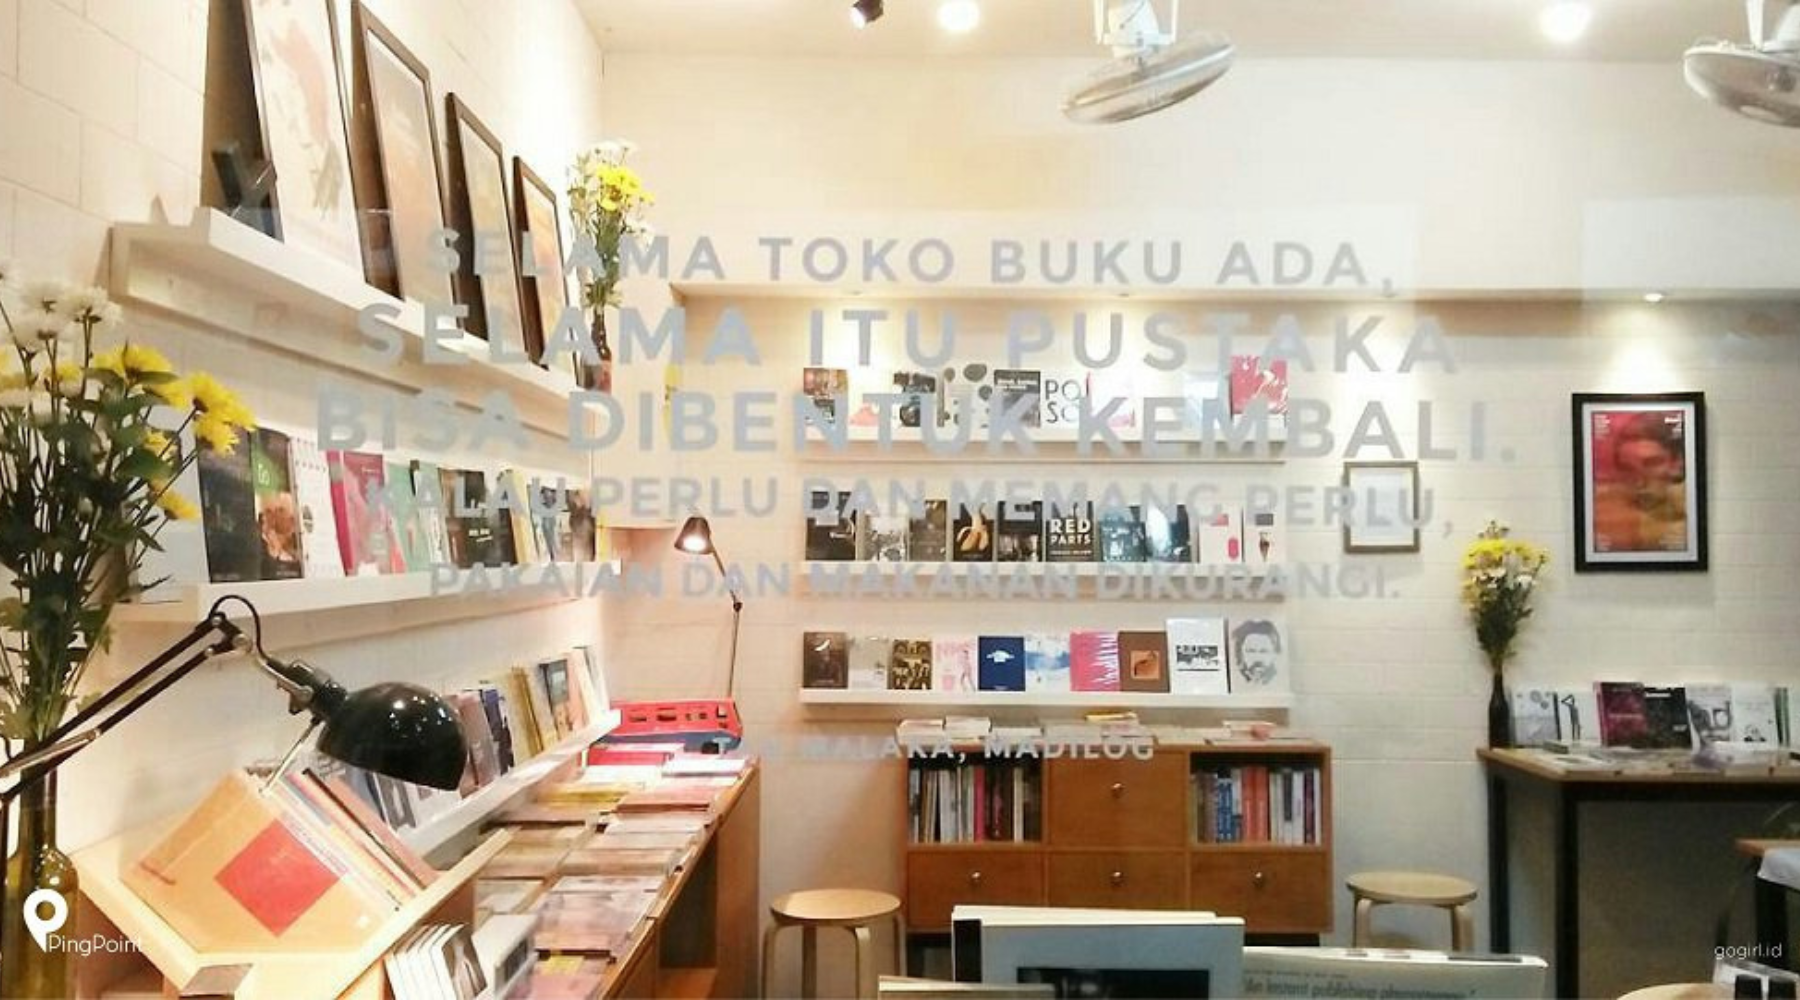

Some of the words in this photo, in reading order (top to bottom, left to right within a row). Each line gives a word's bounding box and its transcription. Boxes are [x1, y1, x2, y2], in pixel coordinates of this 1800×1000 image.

[428, 227, 726, 279] SELAMA
[759, 237, 954, 283] TOKO
[990, 239, 1182, 285] BUKU
[1216, 241, 1397, 298] ADA,
[358, 302, 762, 367] SELAMA
[810, 309, 956, 368] ITU
[1008, 309, 1457, 374] PUSTAKA
[316, 384, 532, 452] BISA
[567, 388, 1039, 458] DIBENTUK
[1076, 396, 1516, 462] KEMBALI.
[366, 473, 568, 520] KALAU
[591, 477, 778, 519] PERLU
[803, 477, 926, 520] DAN
[951, 479, 1219, 522] MEMANG
[1244, 484, 1454, 539] PERLU,
[1050, 518, 1092, 534] RED
[1050, 534, 1092, 546] PARTS
[430, 559, 664, 598] PAKAIAN
[683, 561, 789, 598] DAN
[809, 561, 1076, 599] MAKANAN
[1099, 563, 1401, 600] DIKURANGI.
[984, 734, 1154, 761] MADILOG
